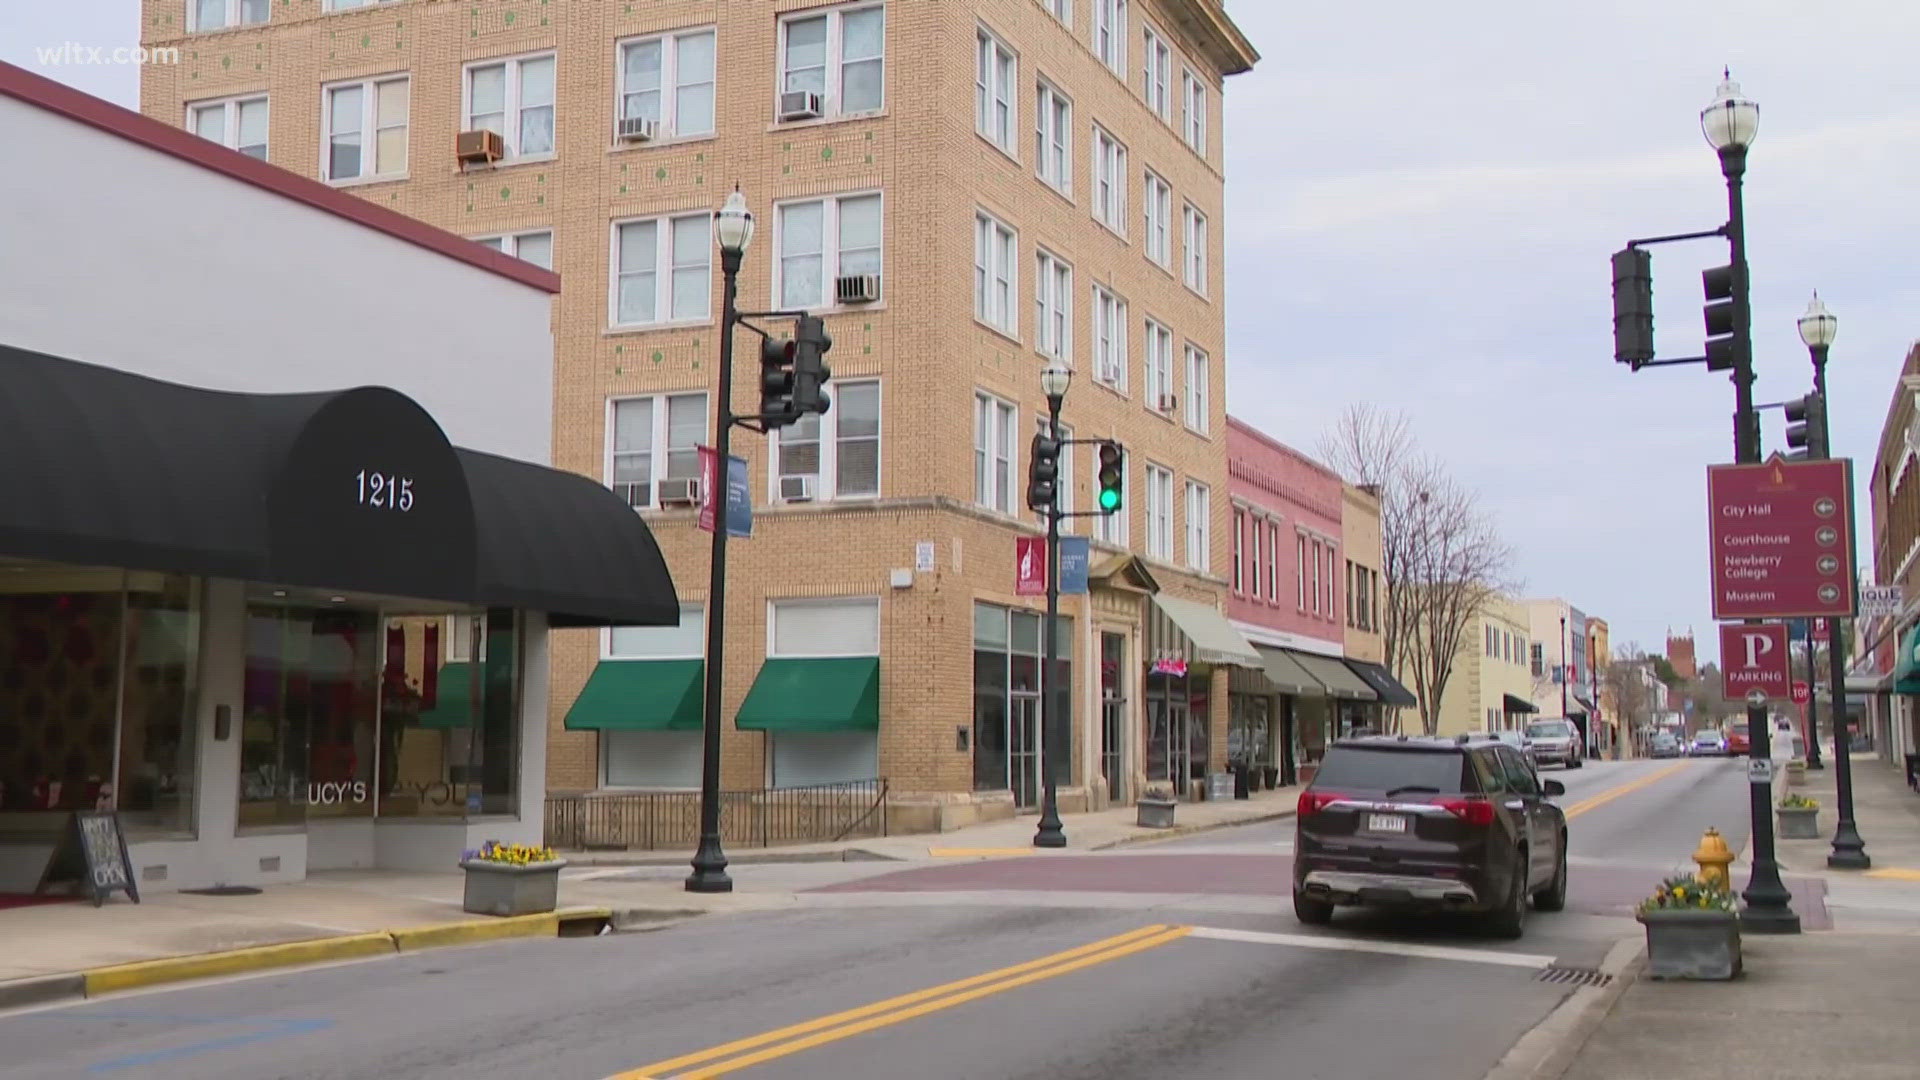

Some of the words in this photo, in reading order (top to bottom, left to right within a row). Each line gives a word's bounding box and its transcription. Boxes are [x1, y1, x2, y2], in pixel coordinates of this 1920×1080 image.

[356, 468, 414, 512] 1215
[1722, 505, 1745, 518] City
[1748, 504, 1771, 515] Hall
[1723, 533, 1791, 546] Courthouse
[1725, 555, 1782, 567] Newberry
[1725, 567, 1768, 580] College
[1726, 590, 1776, 602] Museum
[1861, 588, 1901, 601] IQUE
[1741, 633, 1774, 668] P
[1729, 671, 1782, 682] PARKING
[1793, 687, 1809, 699] TOP
